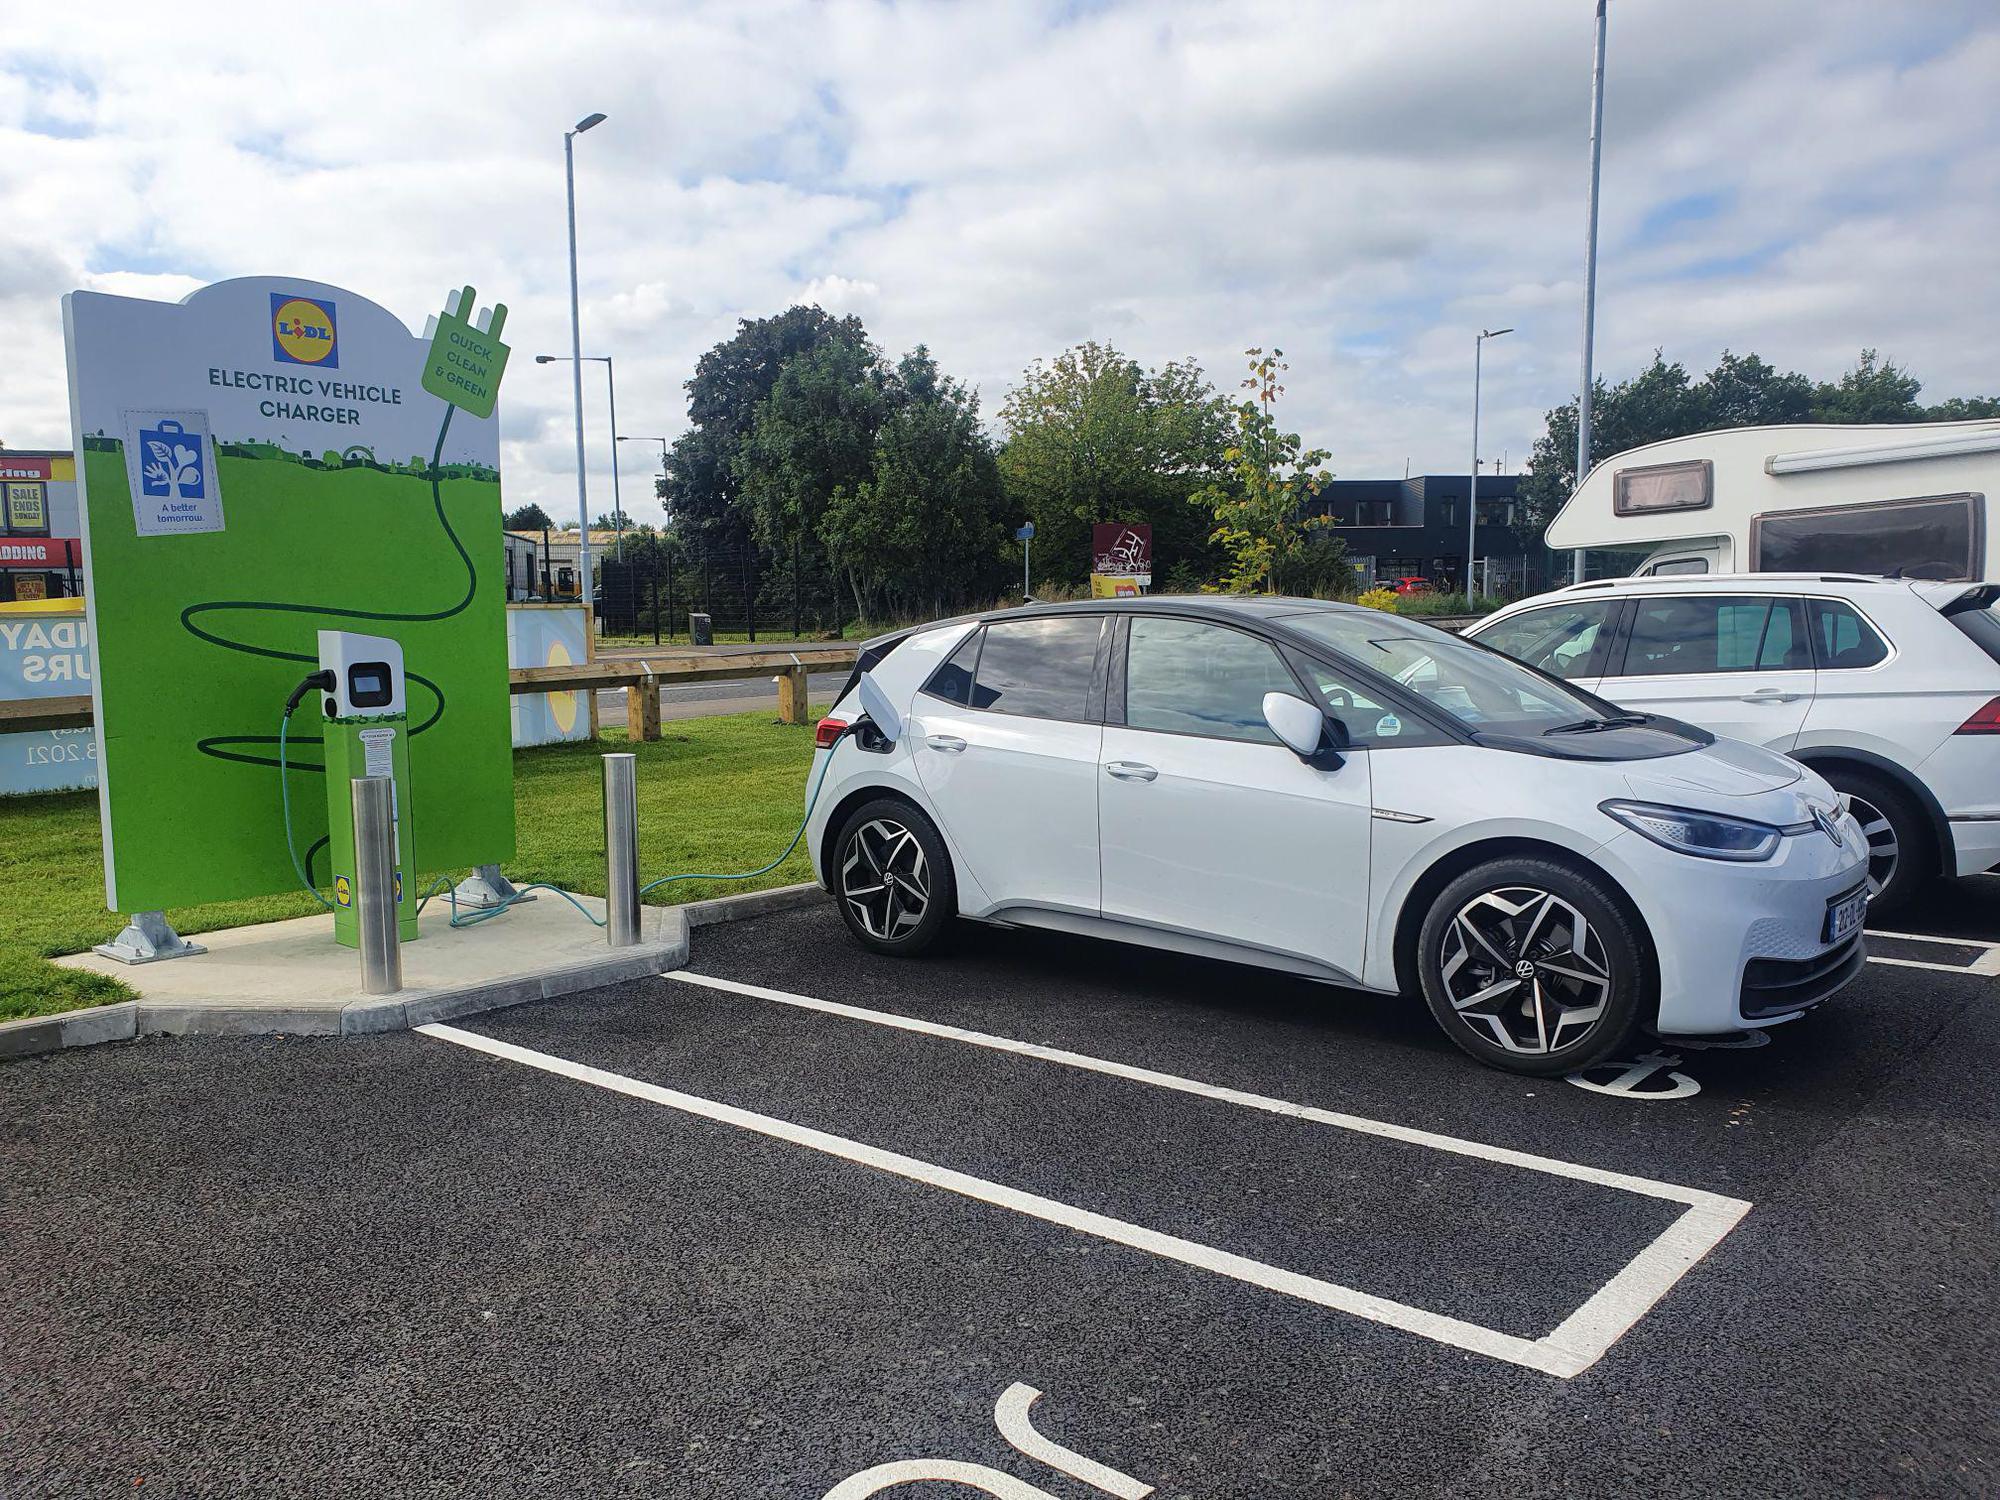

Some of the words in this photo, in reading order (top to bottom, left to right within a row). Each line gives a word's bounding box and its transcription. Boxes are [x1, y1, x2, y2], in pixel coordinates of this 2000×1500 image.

[447, 351, 487, 378] CLEAN
[208, 368, 313, 396] ELECTRIC
[318, 380, 402, 405] VEHICLE
[435, 366, 444, 377] &
[446, 371, 487, 399] GREEN
[260, 400, 361, 425] CHARGER
[12, 488, 39, 500] SALE
[13, 501, 40, 511] ENDS
[162, 504, 169, 512] A
[170, 503, 197, 512] better
[14, 512, 40, 520] SUNDAY
[0, 545, 47, 560] DDING
